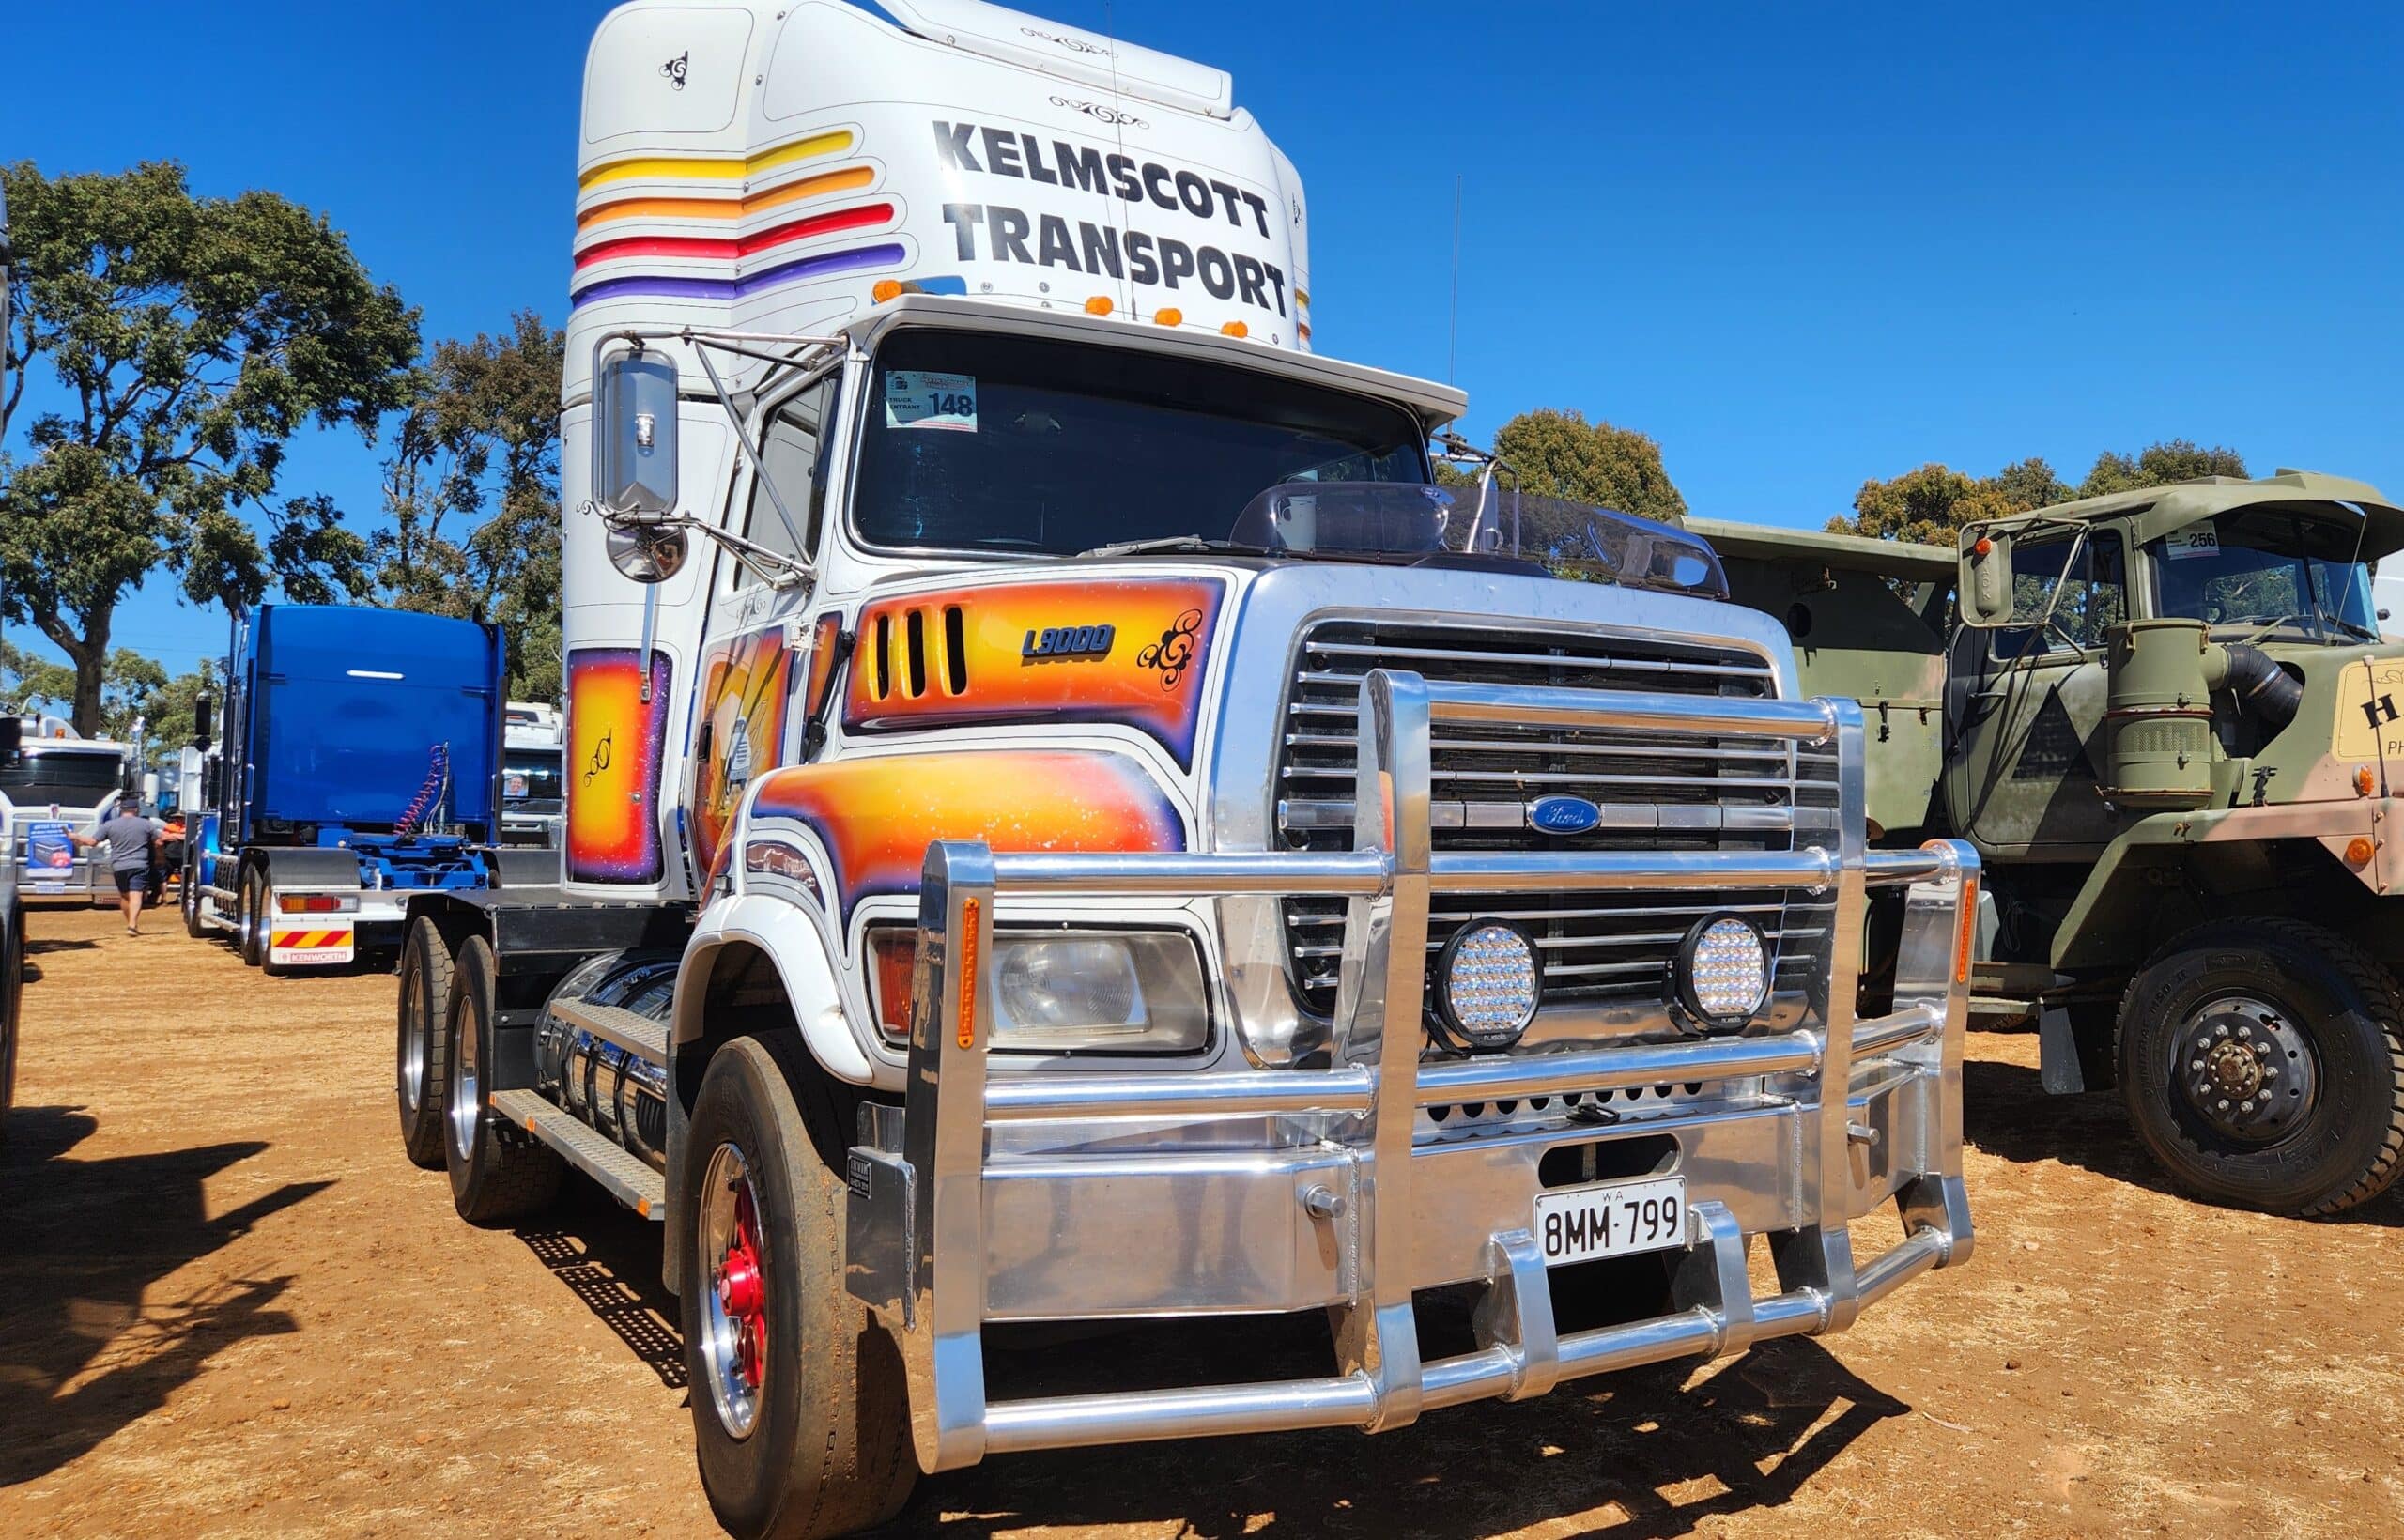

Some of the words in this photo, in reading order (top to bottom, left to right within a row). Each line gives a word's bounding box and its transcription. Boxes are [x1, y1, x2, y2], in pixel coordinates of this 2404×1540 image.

[932, 120, 1271, 240] KELMSCOTT
[943, 203, 1286, 318] TRANSPORT
[928, 393, 973, 418] 148
[2189, 532, 2216, 548] 256
[1546, 805, 1585, 824] Ford
[291, 951, 346, 962] KENWORTH
